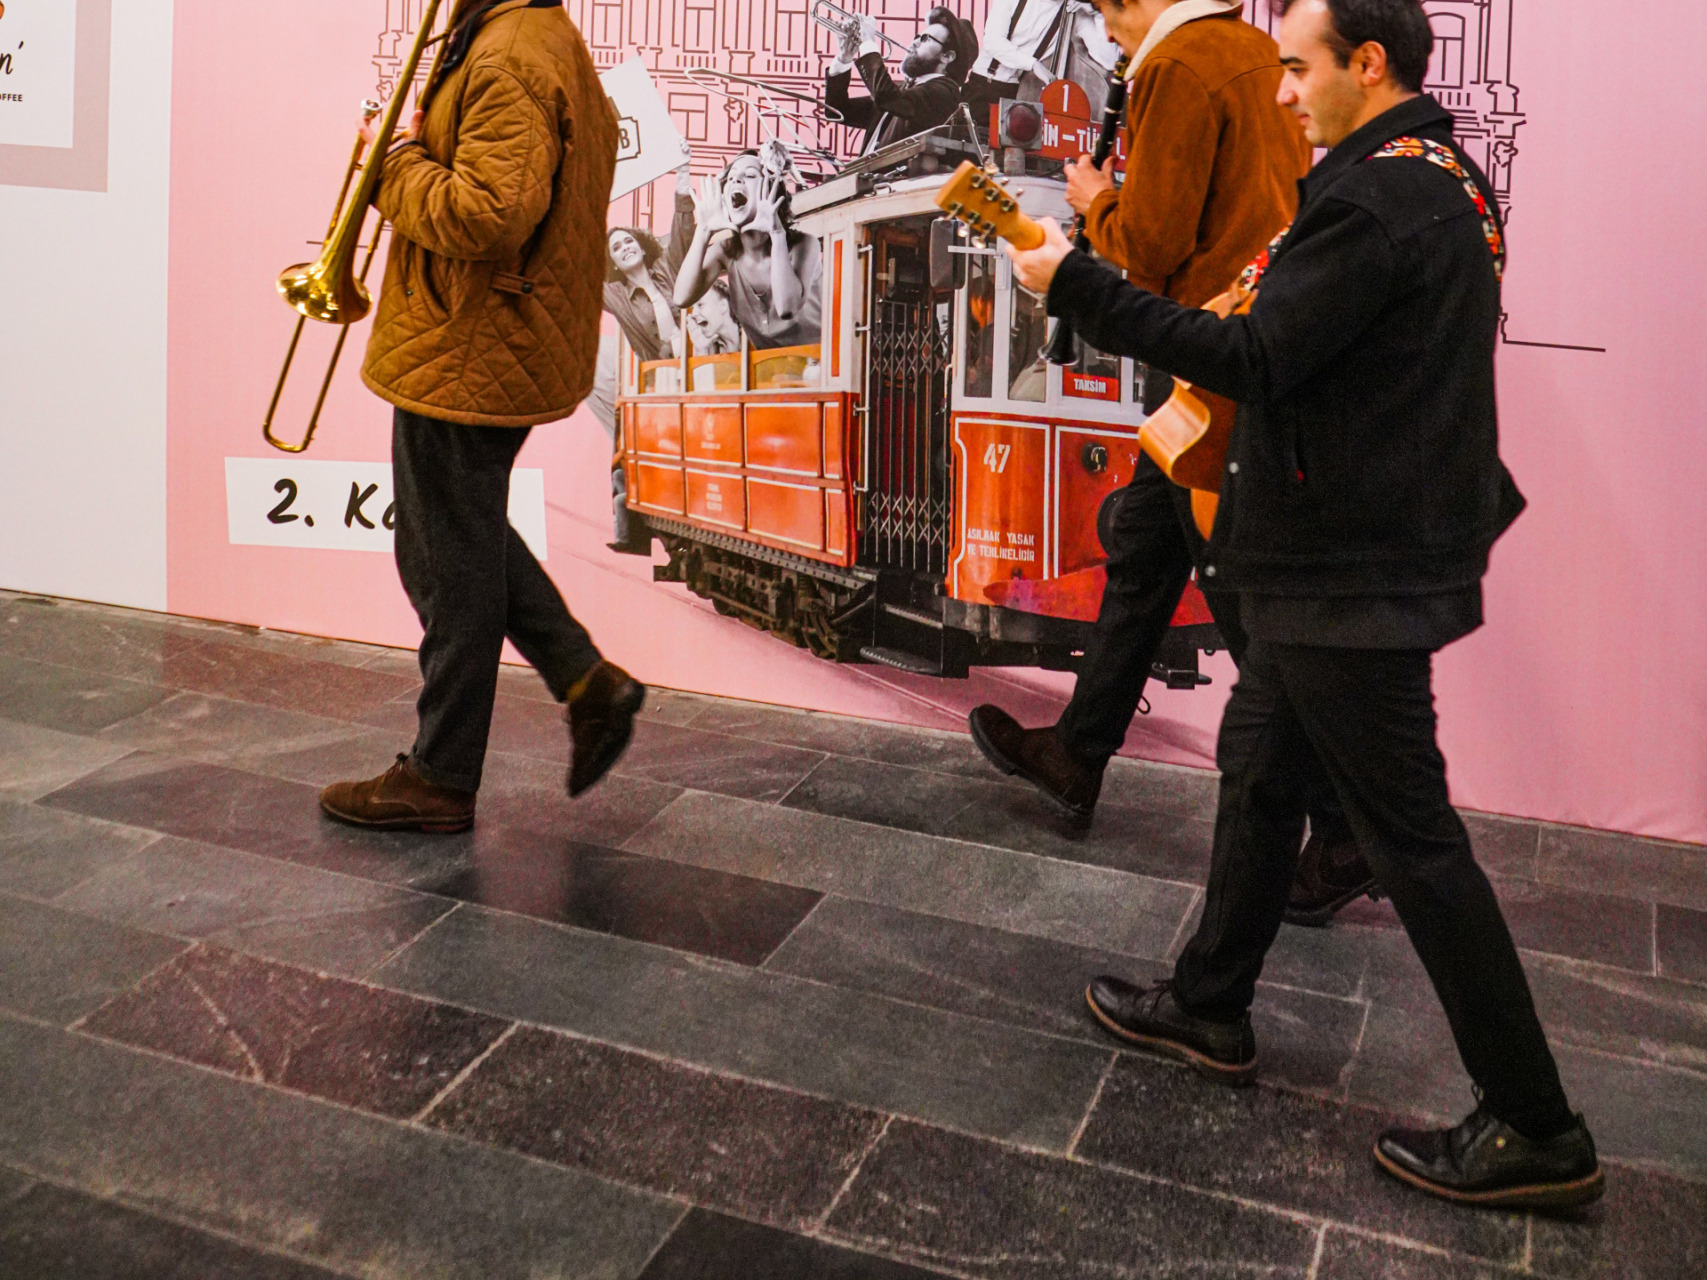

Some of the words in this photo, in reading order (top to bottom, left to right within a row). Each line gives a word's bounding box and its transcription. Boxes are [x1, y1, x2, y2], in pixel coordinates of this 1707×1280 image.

[1062, 84, 1069, 112] 1
[1074, 378, 1107, 394] TAKSİM
[984, 443, 1011, 473] 47
[267, 478, 315, 528] 2.
[1006, 531, 1035, 546] YASAK
